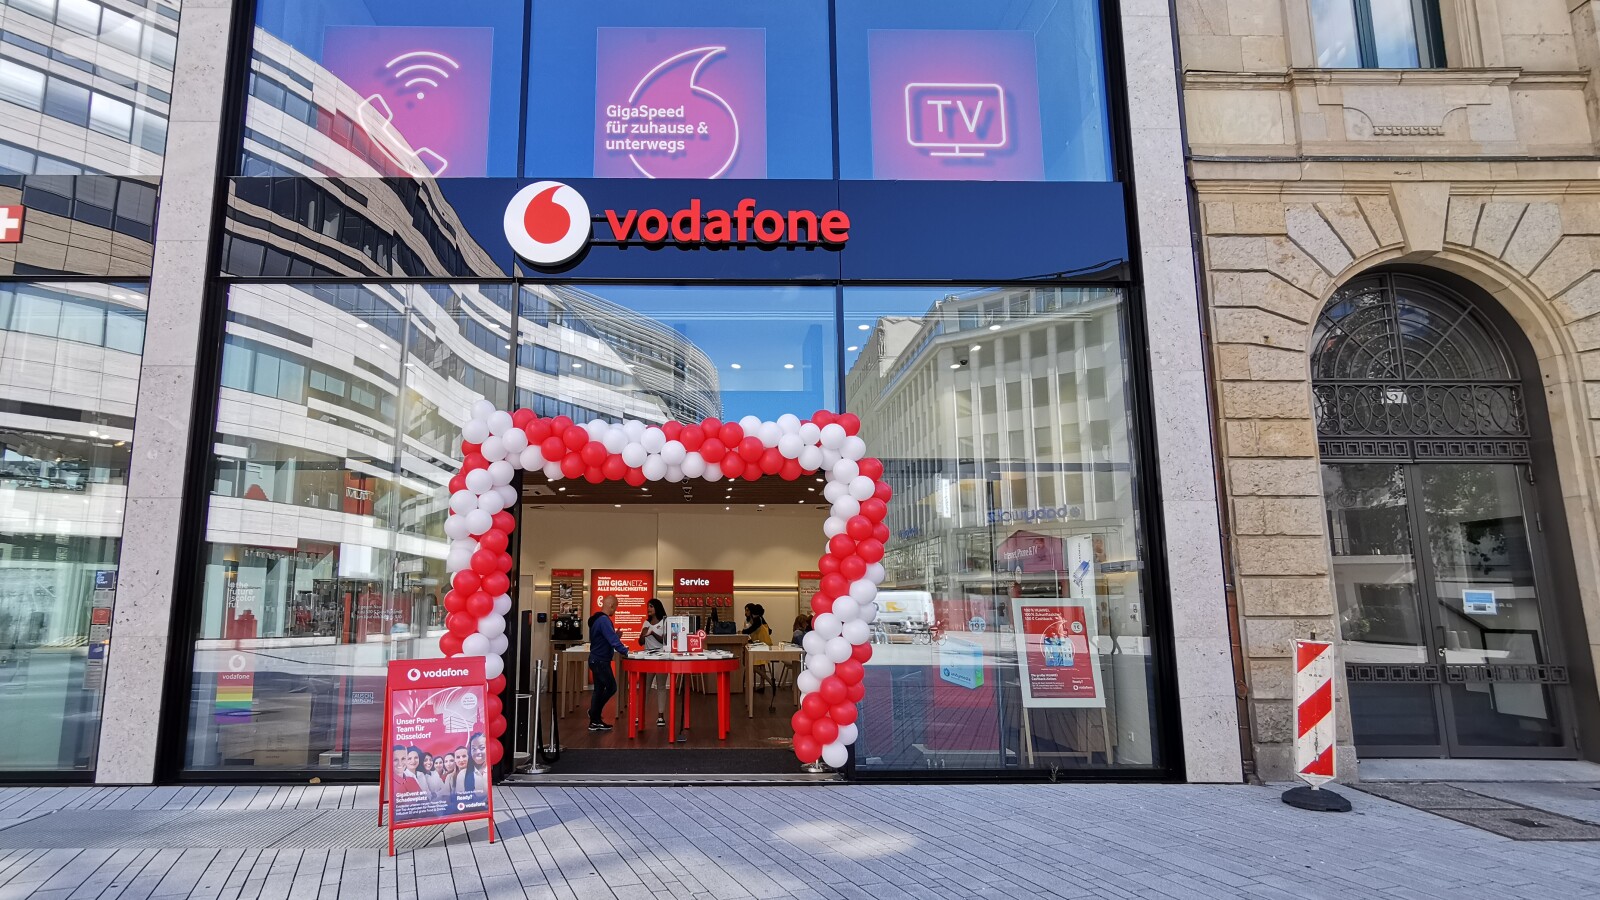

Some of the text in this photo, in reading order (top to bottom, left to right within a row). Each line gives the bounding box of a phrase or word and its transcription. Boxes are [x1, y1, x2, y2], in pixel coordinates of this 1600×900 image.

[606, 105, 684, 120] GigaSpeed
[927, 100, 983, 132] TV
[606, 122, 708, 134] für zuhause &
[606, 138, 685, 153] unterwegs
[604, 198, 850, 242] vodafone
[680, 578, 710, 586] Service
[423, 668, 469, 678] vodafone
[396, 732, 432, 740] Düsseldorf
